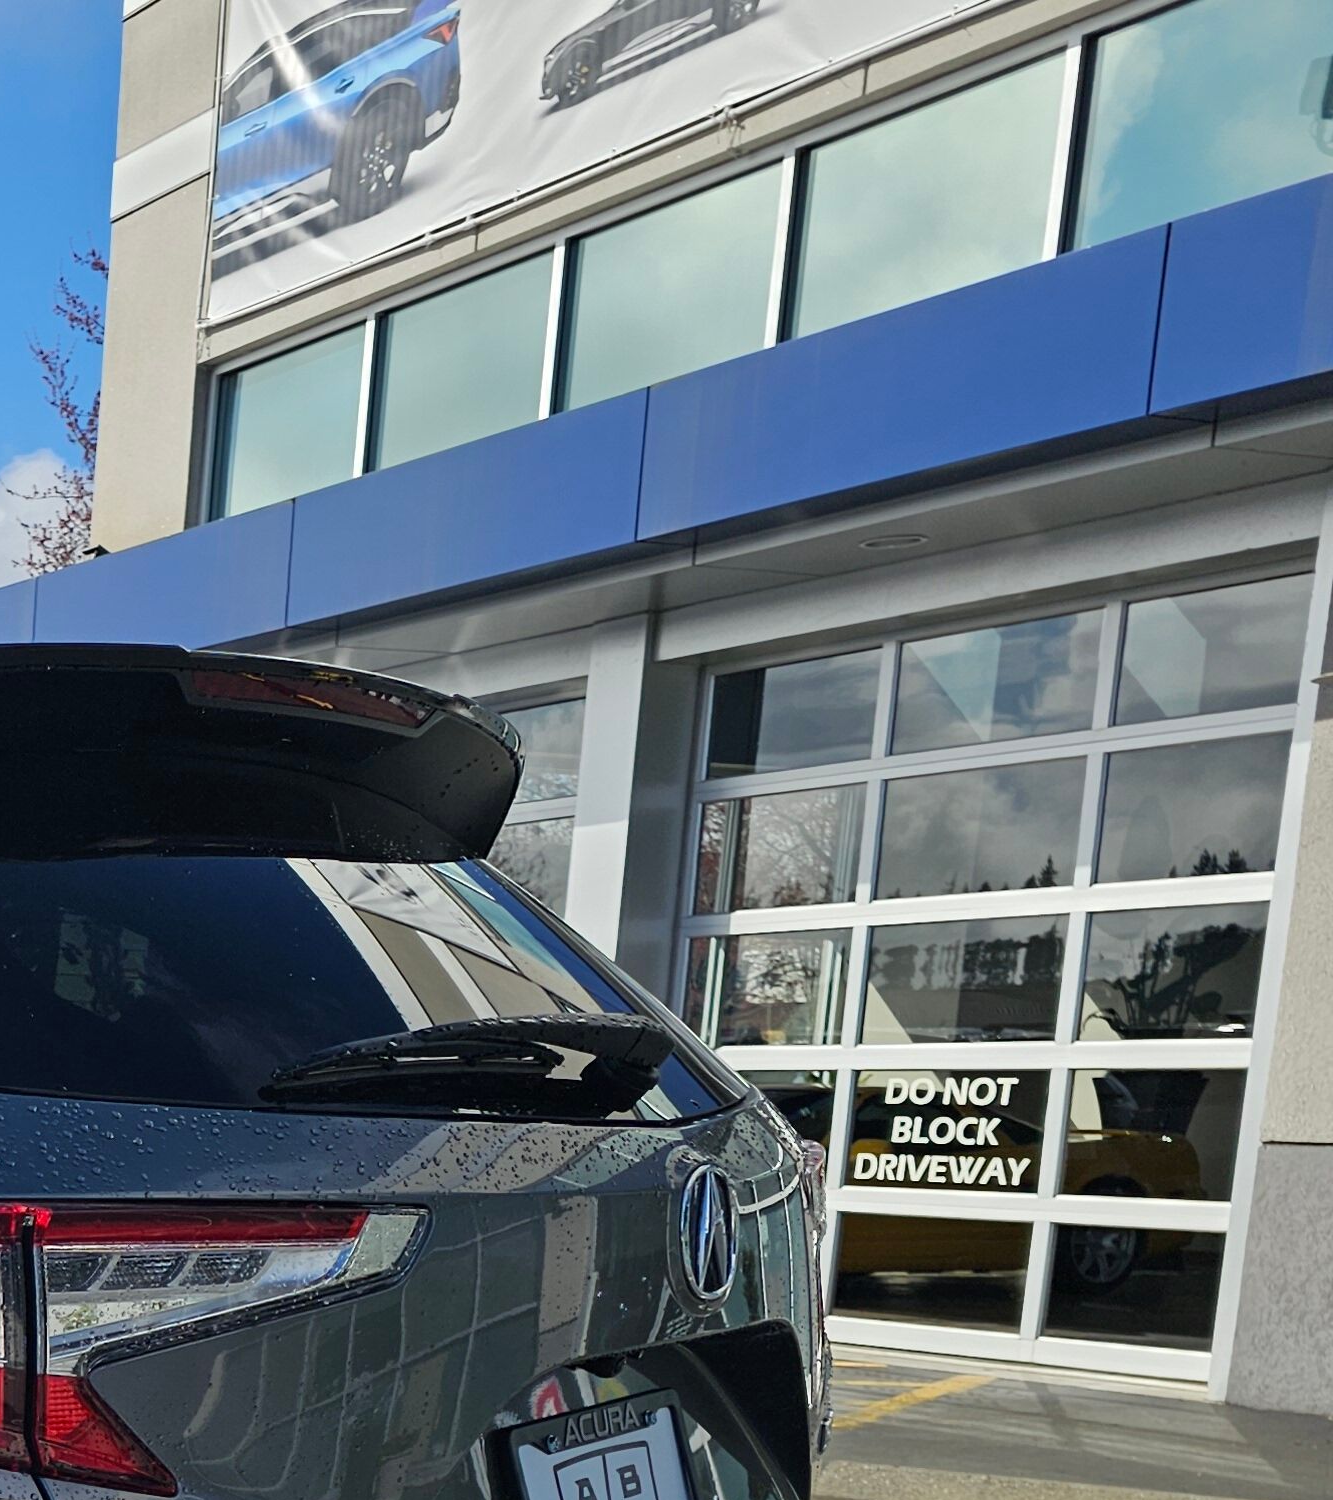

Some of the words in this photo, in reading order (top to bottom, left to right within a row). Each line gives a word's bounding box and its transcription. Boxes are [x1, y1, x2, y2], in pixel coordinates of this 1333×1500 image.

[884, 1077, 936, 1106] DO
[942, 1077, 1020, 1107] NOT
[890, 1115, 1002, 1146] BLOCK
[853, 1152, 1032, 1187] DRIVEWAY
[563, 1401, 640, 1447] ACURA
